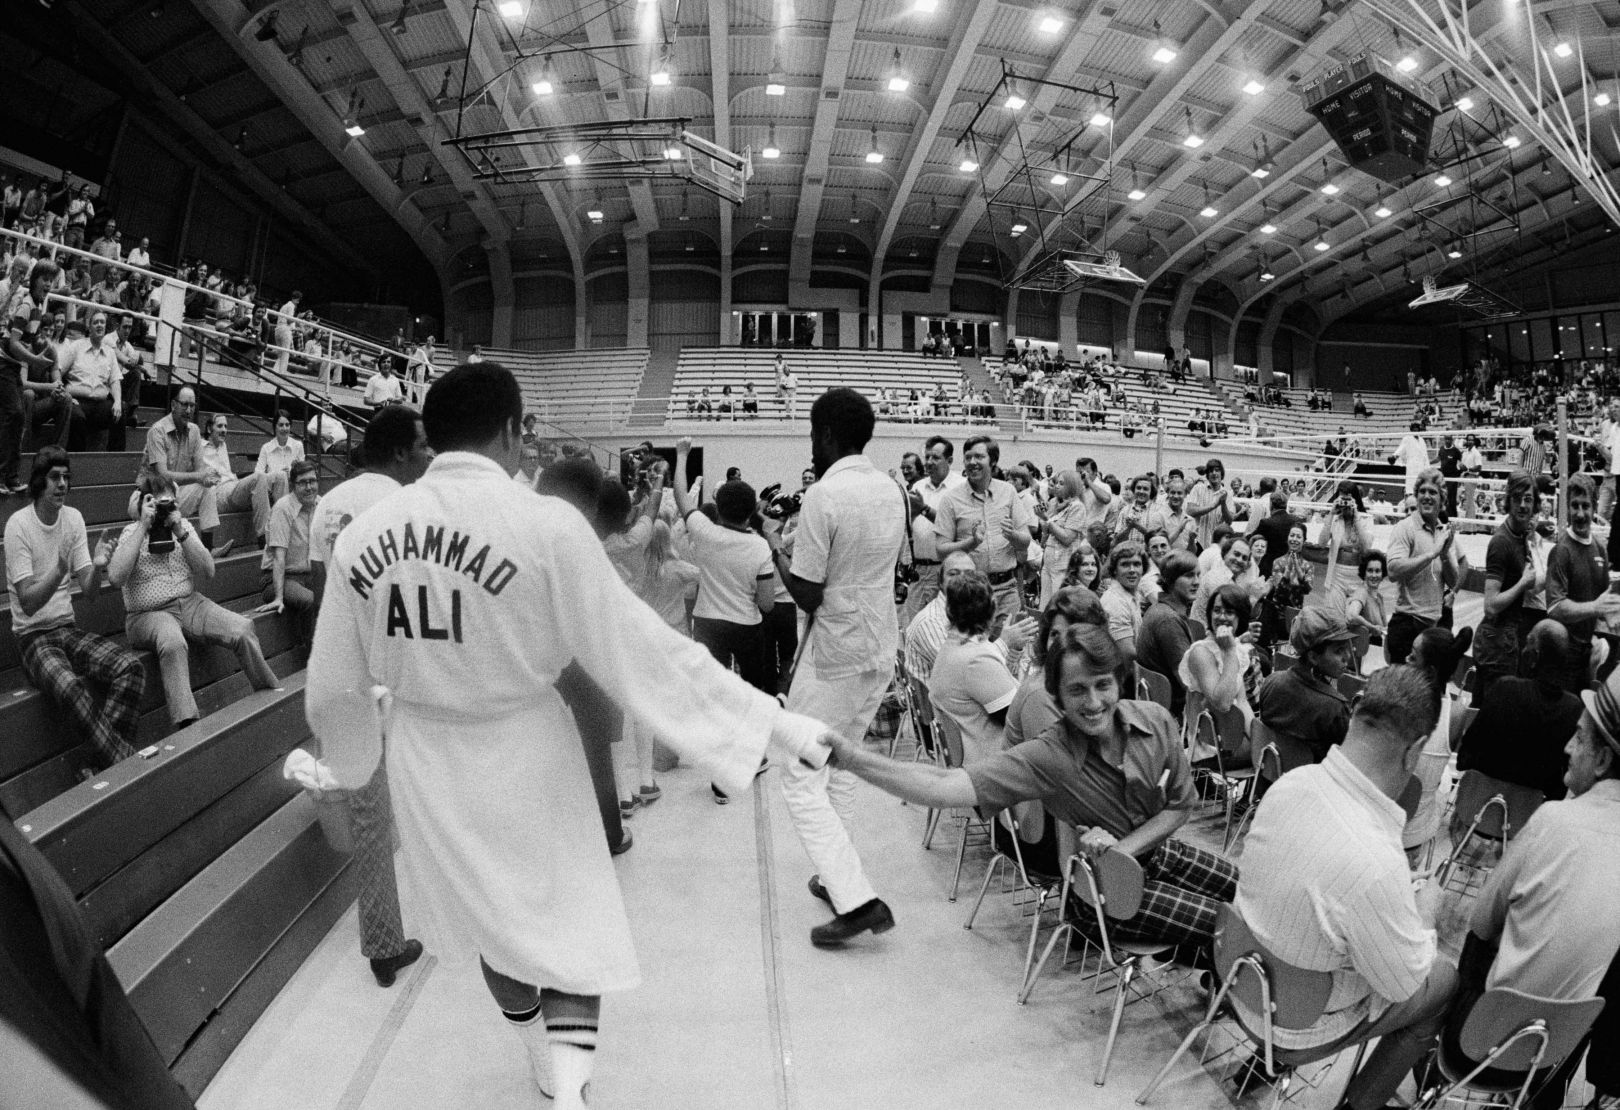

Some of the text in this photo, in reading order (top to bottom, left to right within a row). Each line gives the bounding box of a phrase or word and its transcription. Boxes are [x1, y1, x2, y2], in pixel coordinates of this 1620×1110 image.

[1324, 64, 1344, 80] PLAYER
[1348, 52, 1366, 65] FOULS
[1322, 83, 1373, 115] HOME VISITOR
[1385, 84, 1402, 100] HOME
[1353, 128, 1371, 141] PERIOD
[1401, 128, 1416, 143] PERIOD
[350, 522, 518, 600] MUHAMMAD
[387, 583, 463, 643] ALI
